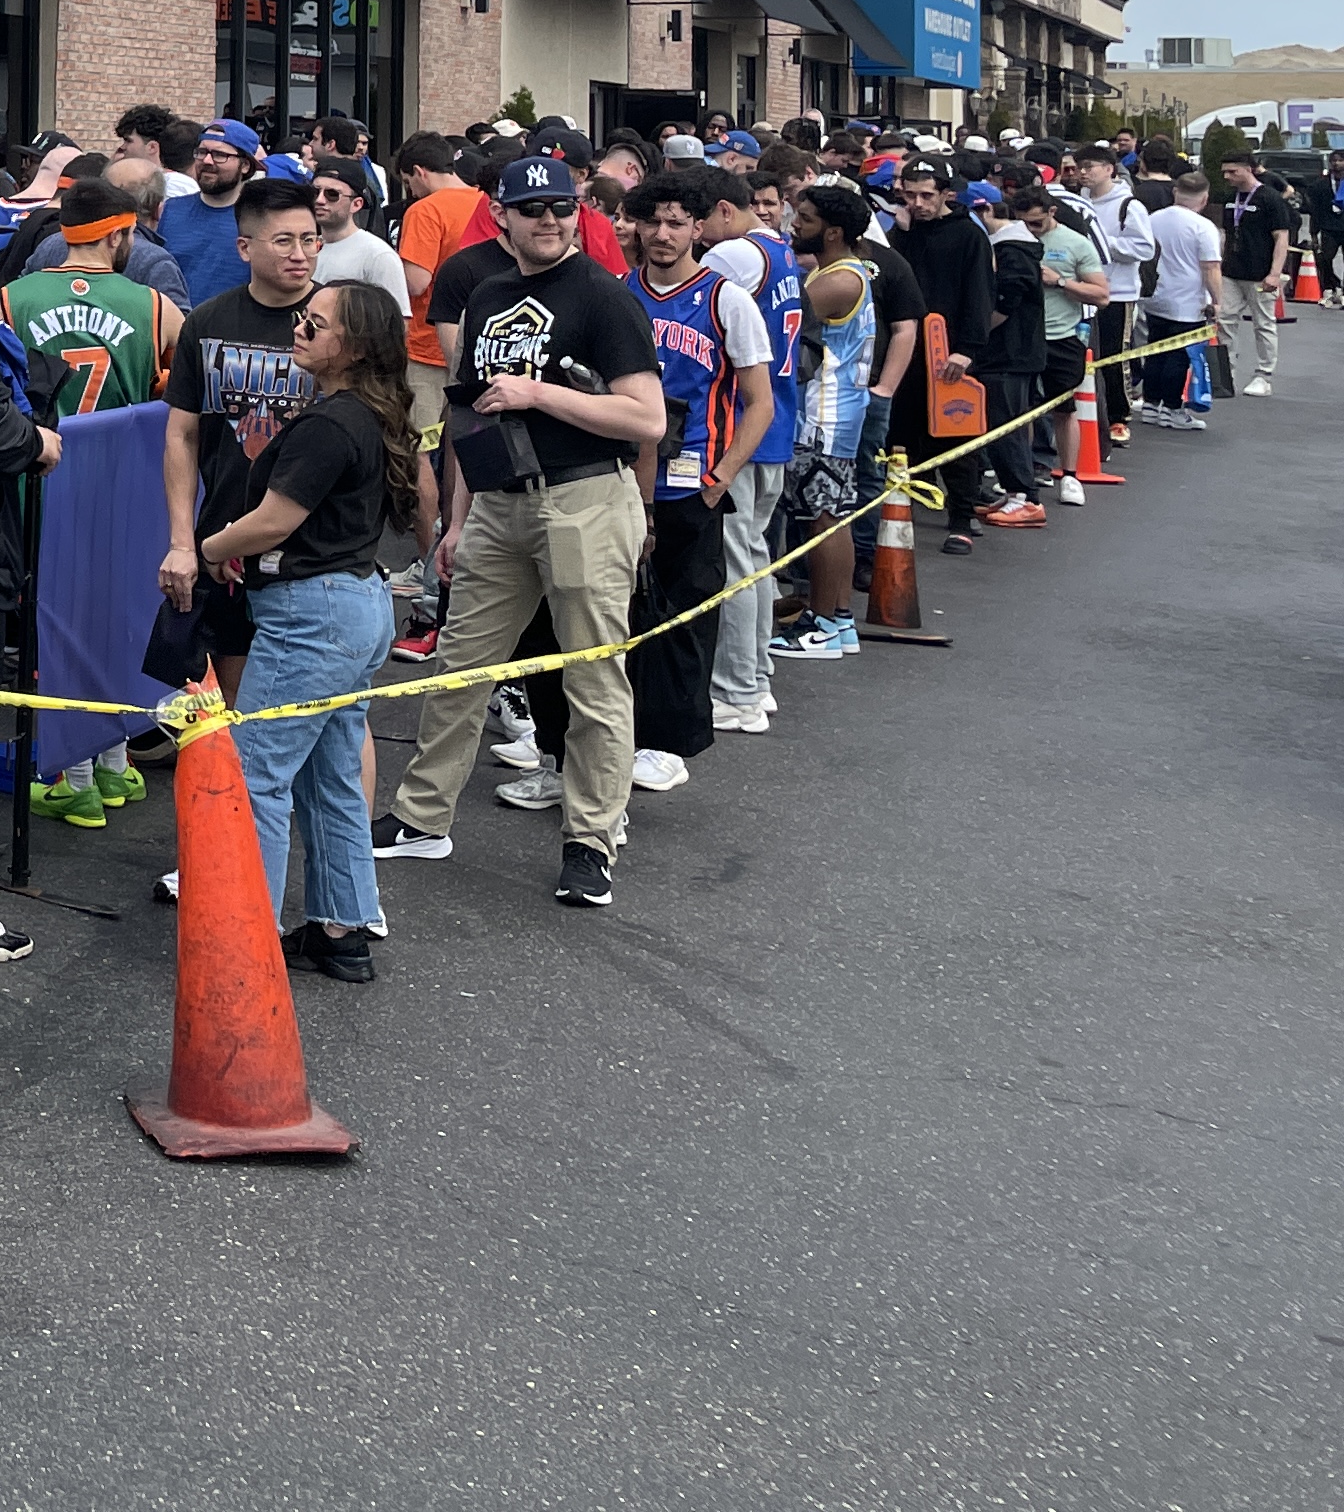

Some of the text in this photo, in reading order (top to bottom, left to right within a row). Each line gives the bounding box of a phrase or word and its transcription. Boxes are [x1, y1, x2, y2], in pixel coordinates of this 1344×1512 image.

[526, 164, 549, 186] NY
[771, 275, 800, 311] ANTH
[28, 304, 135, 347] ANTHONY
[653, 318, 715, 373] YORK
[777, 308, 803, 377] 7
[61, 346, 111, 415] 7
[199, 338, 314, 414] KNICK
[226, 393, 259, 404] NEW
